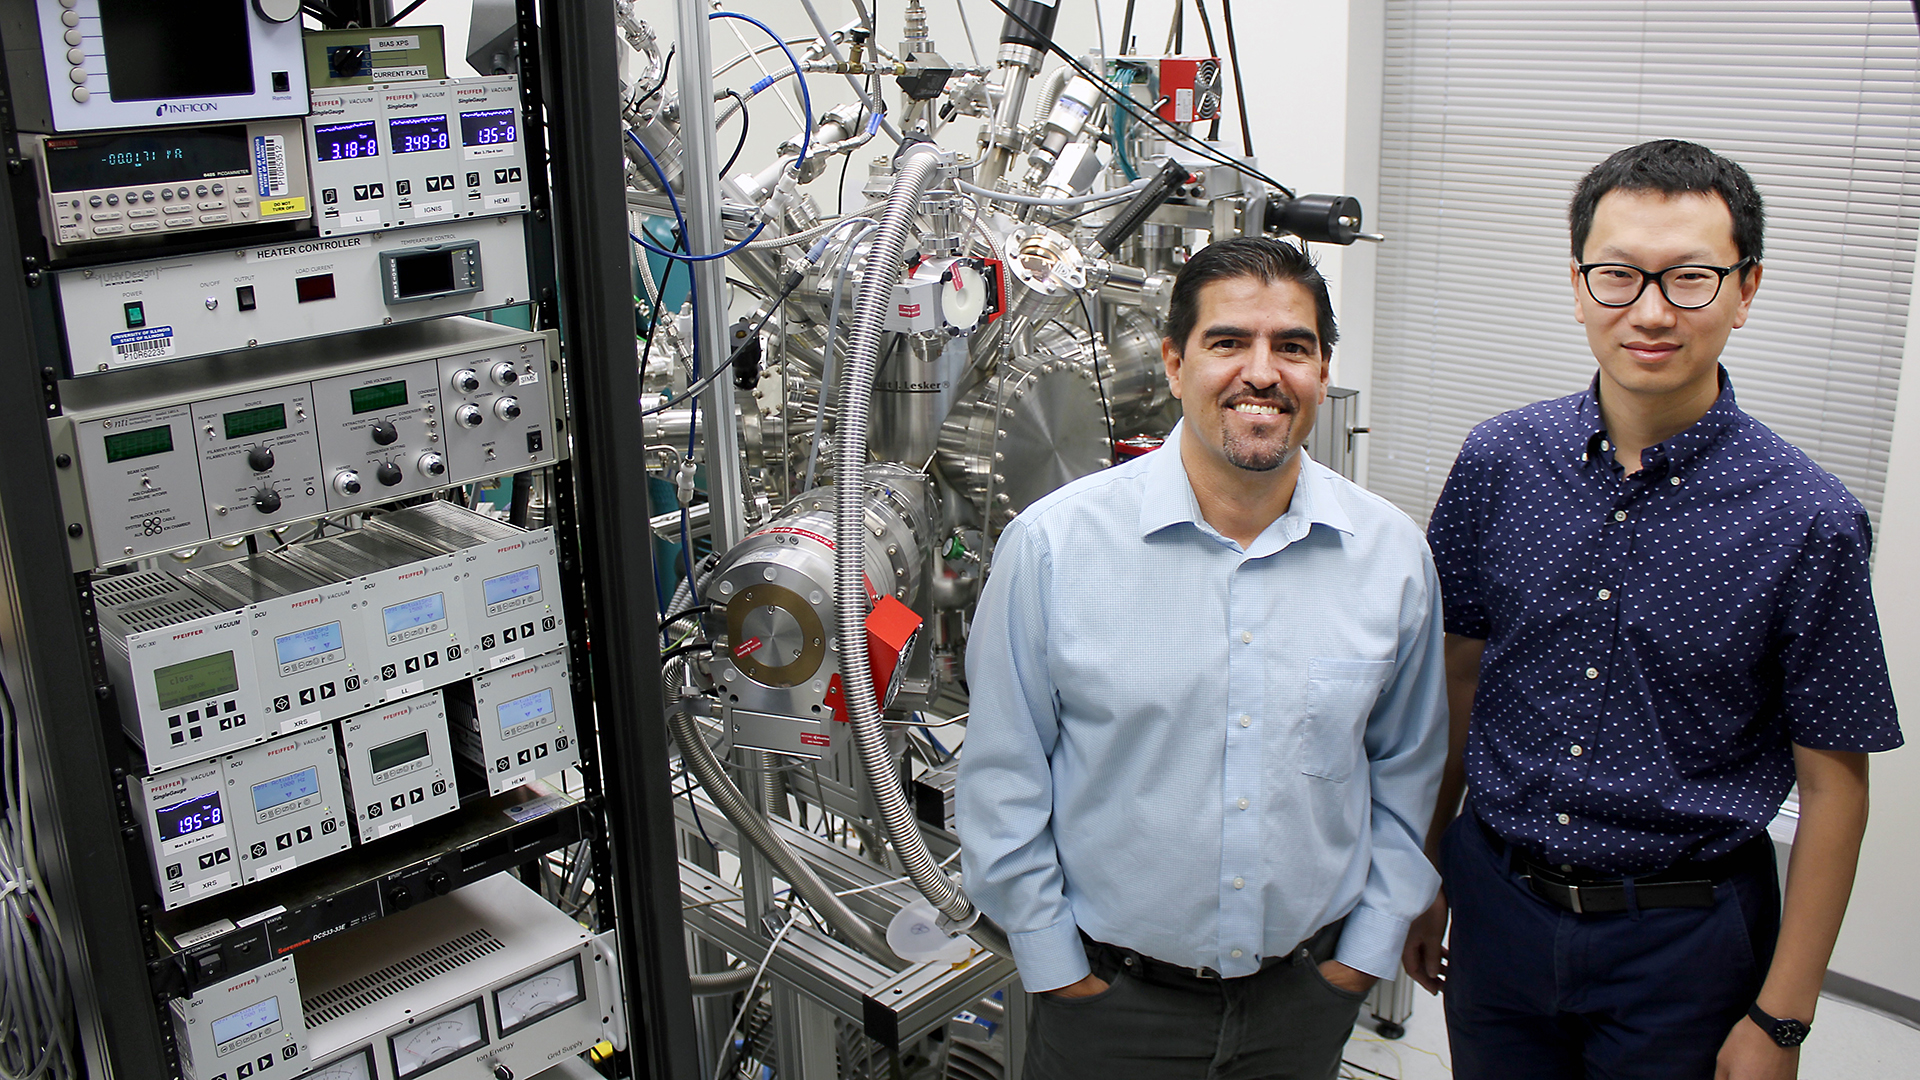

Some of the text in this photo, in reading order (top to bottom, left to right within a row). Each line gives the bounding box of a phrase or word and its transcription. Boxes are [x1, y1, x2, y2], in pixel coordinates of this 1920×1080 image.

[169, 102, 218, 114] INFICON
[405, 133, 447, 152] 3.49-8
[332, 140, 376, 159] 3.18-8
[401, 236, 433, 245] TEMPERATURE
[257, 238, 361, 259] HEATER CONTROLLER
[125, 269, 155, 280] Design
[112, 331, 142, 340] UNIVERSITY
[124, 348, 165, 360] P10R62235
[398, 408, 421, 416] CONDENSER
[114, 417, 128, 428] nti
[498, 537, 548, 553] PFEIFFER VACUUM
[398, 563, 453, 580] PFEIFFER VACUUM
[292, 590, 350, 609] PFEIFFER VACUUM
[173, 620, 241, 640] PFEIFFER VACUUM
[500, 654, 516, 663] IGNIS
[511, 660, 560, 678] PFEIFFER VACUUM
[170, 674, 194, 685] close
[383, 700, 437, 721] PFEIFFER VACUUM
[294, 718, 308, 728] XRS
[267, 735, 326, 756] PFEIFFER VACUUM
[151, 770, 216, 792] PFEIFFER VACUUM
[512, 776, 526, 785] HEMI
[153, 788, 187, 800] SingleGauge
[270, 865, 282, 873] DPI
[202, 879, 218, 889] XRS
[313, 924, 346, 941] DCS33-33E
[278, 939, 311, 954] Sorensen
[228, 966, 287, 993] PFEIFFER VACUUM
[191, 999, 204, 1008] DCU
[431, 1036, 442, 1044] mA
[476, 1042, 515, 1063] Ion Energy
[547, 1040, 584, 1060] Grid Supply
